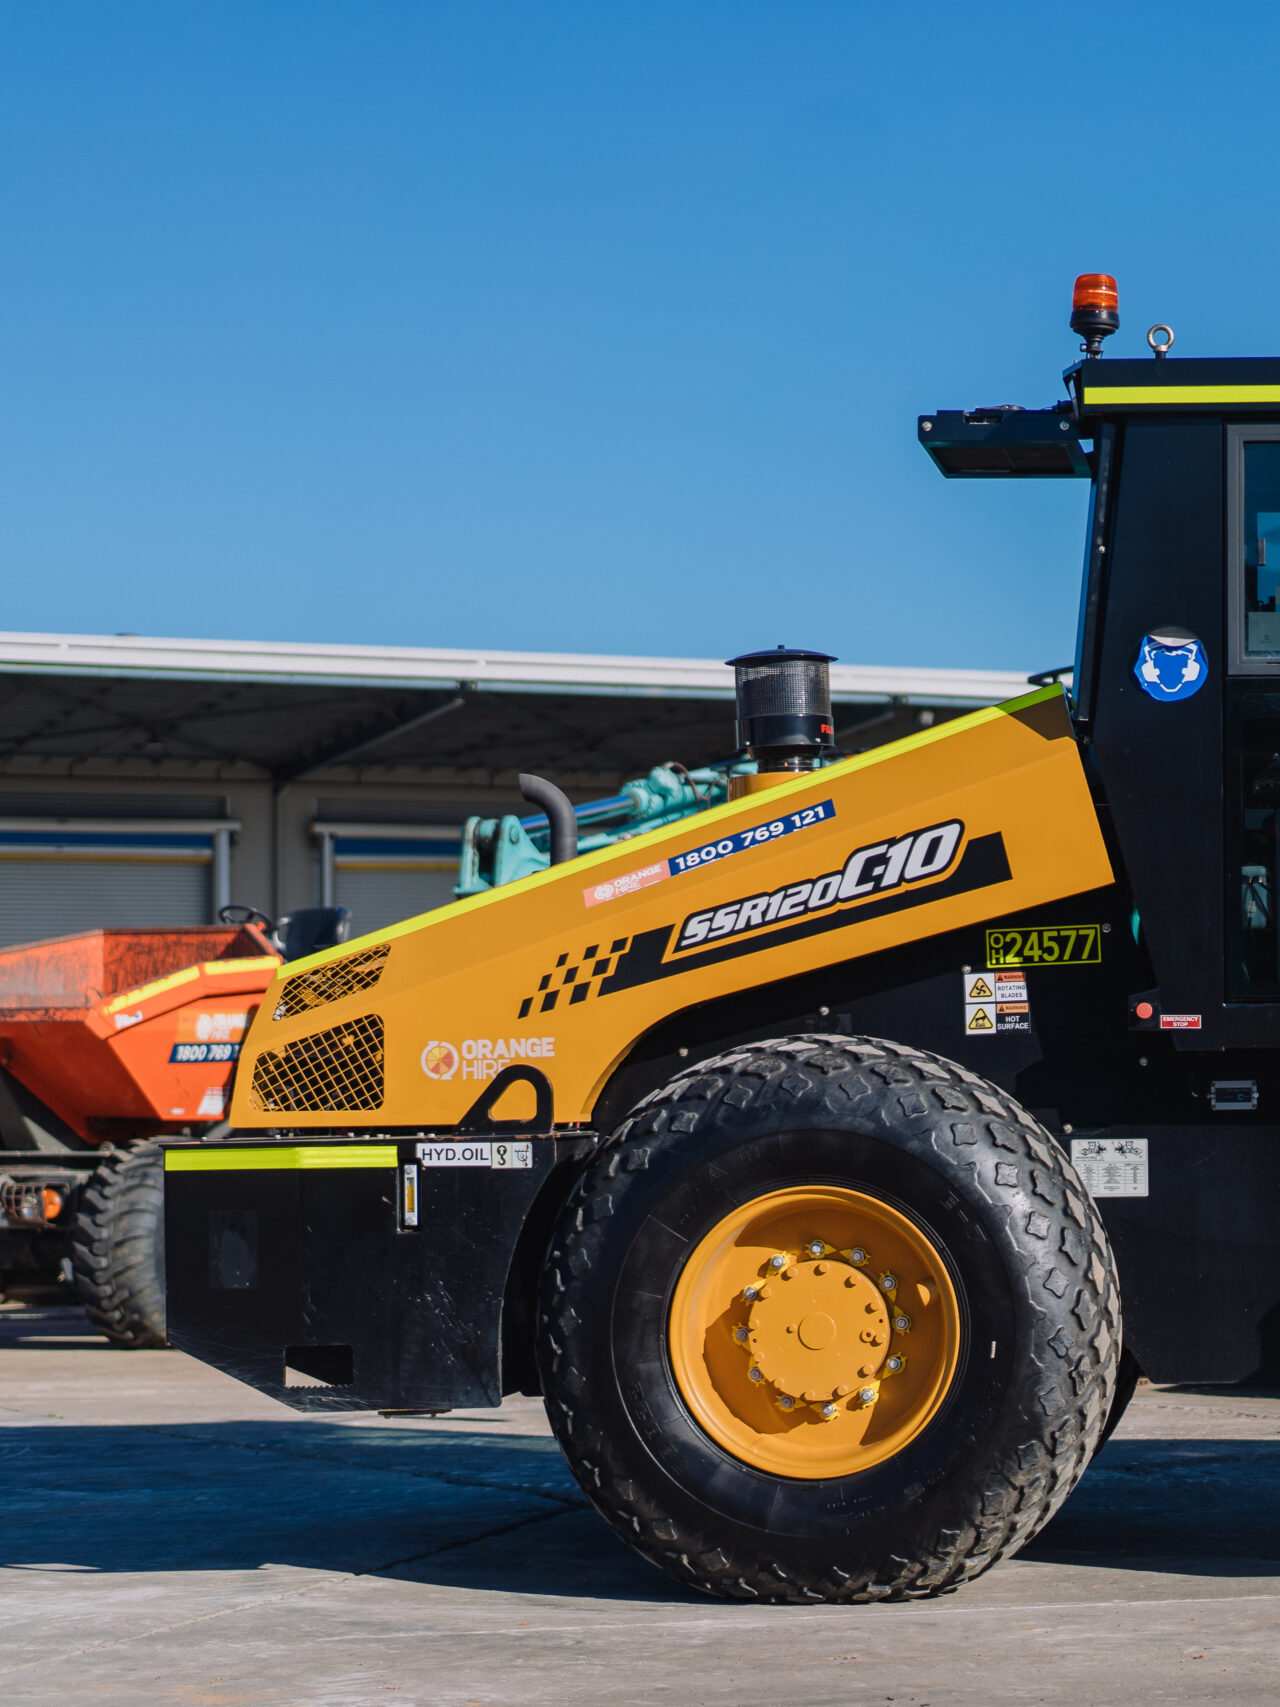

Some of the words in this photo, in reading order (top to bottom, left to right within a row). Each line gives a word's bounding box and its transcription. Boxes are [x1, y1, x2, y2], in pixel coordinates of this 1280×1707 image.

[675, 840, 734, 870] 1800
[741, 821, 785, 847] 769
[791, 805, 826, 828] 121
[613, 864, 663, 887] ORANGE
[1005, 929, 1096, 963] 24577
[997, 1022, 1029, 1030] SURFACE
[176, 1044, 208, 1061] 1800
[461, 1037, 556, 1059] ORANGE
[421, 1148, 490, 1161] HYD.OIL
